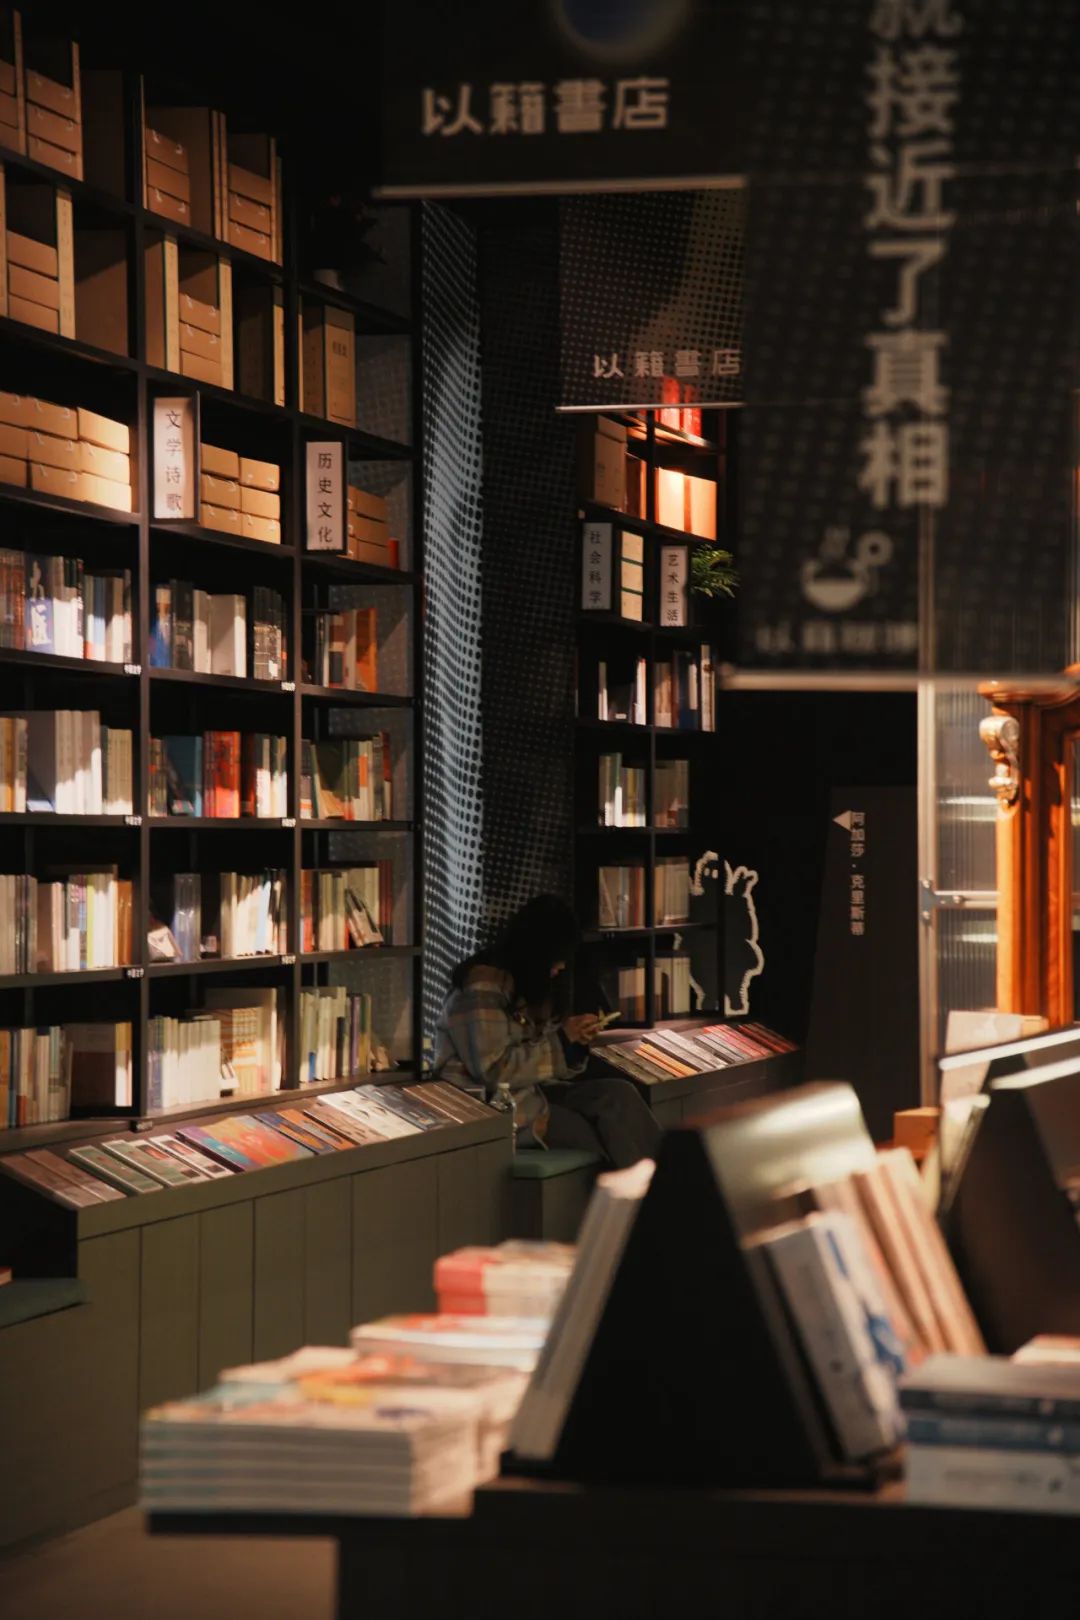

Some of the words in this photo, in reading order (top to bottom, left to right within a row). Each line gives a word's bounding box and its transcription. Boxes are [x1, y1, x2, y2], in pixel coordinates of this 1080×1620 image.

[421, 75, 671, 137] 以籍書店
[165, 409, 182, 511] 文学诗歌
[317, 452, 333, 543] 历史文化
[589, 530, 602, 603] 社会科学
